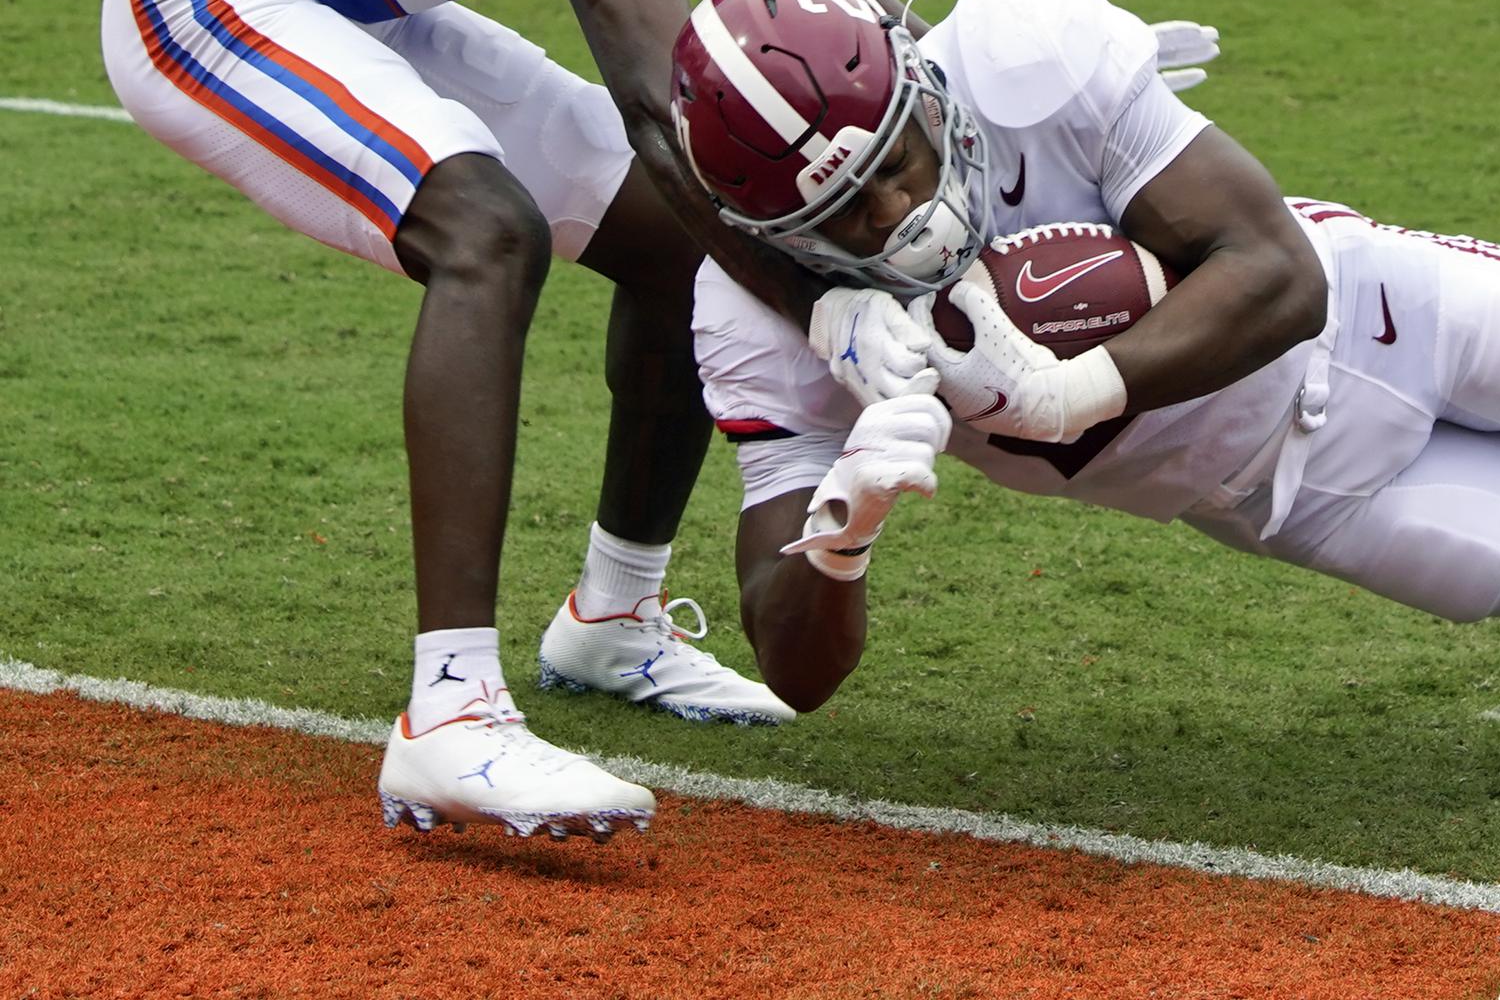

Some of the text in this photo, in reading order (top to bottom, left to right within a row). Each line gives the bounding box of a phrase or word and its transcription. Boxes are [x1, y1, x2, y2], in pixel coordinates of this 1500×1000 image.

[809, 146, 851, 186] BAMA
[1032, 310, 1130, 334] VAPOR ELITE
